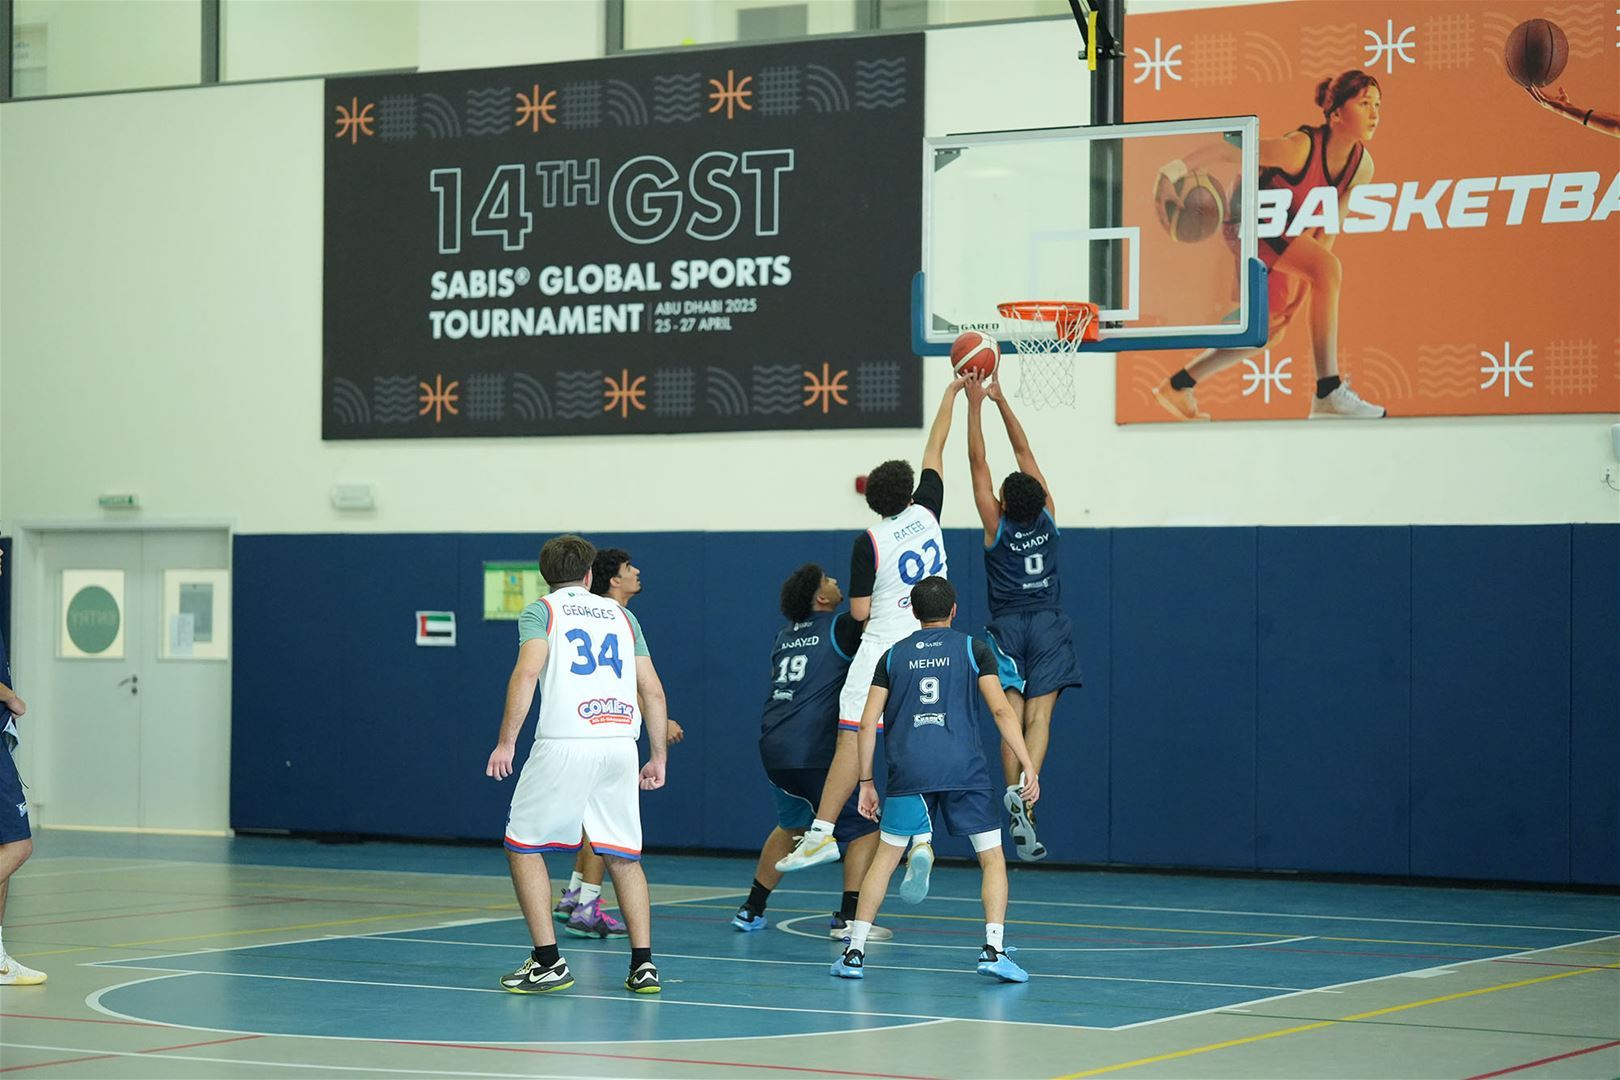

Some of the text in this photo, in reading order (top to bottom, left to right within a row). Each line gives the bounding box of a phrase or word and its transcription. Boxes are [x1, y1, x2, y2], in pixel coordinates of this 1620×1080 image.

[608, 149, 794, 245] GST
[538, 261, 661, 296] GLOBAL
[670, 255, 792, 290] SPORTS
[654, 298, 758, 316] ABU DHABI 2025
[429, 303, 644, 339] TOURNAMENT
[654, 318, 671, 333] 25
[680, 317, 697, 333] 27
[697, 316, 732, 332] APRIL
[961, 323, 999, 331] GARED
[893, 520, 925, 542] RATEB
[1022, 533, 1049, 550] HADY
[898, 538, 944, 585] 02
[1024, 552, 1044, 575] 0
[562, 604, 616, 620] GEORGES
[565, 628, 623, 679] 34
[908, 657, 950, 670] MEHWI
[776, 654, 808, 683] 19
[919, 676, 940, 704] 9
